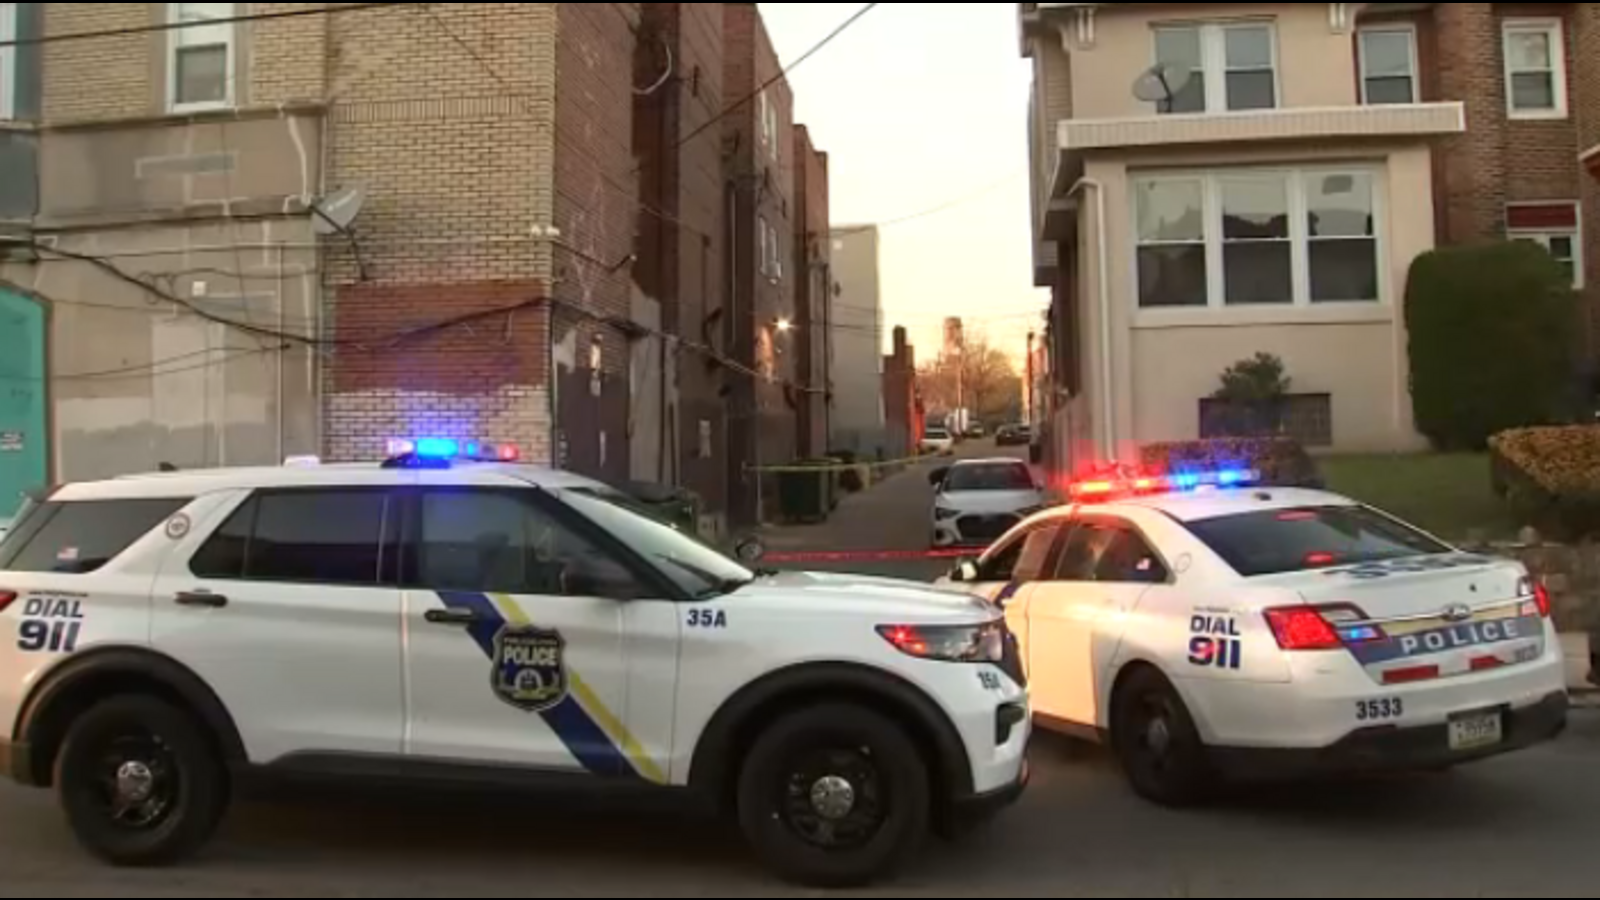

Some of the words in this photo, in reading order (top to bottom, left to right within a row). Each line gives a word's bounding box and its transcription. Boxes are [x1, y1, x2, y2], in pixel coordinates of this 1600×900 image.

[22, 598, 84, 618] DIAL
[687, 608, 727, 628] 35A
[17, 619, 81, 652] 911
[1190, 615, 1241, 636] DIAL
[1401, 621, 1520, 654] POLICE
[503, 643, 558, 667] POLICE
[1187, 636, 1242, 669] 911
[1355, 697, 1403, 720] 3533
